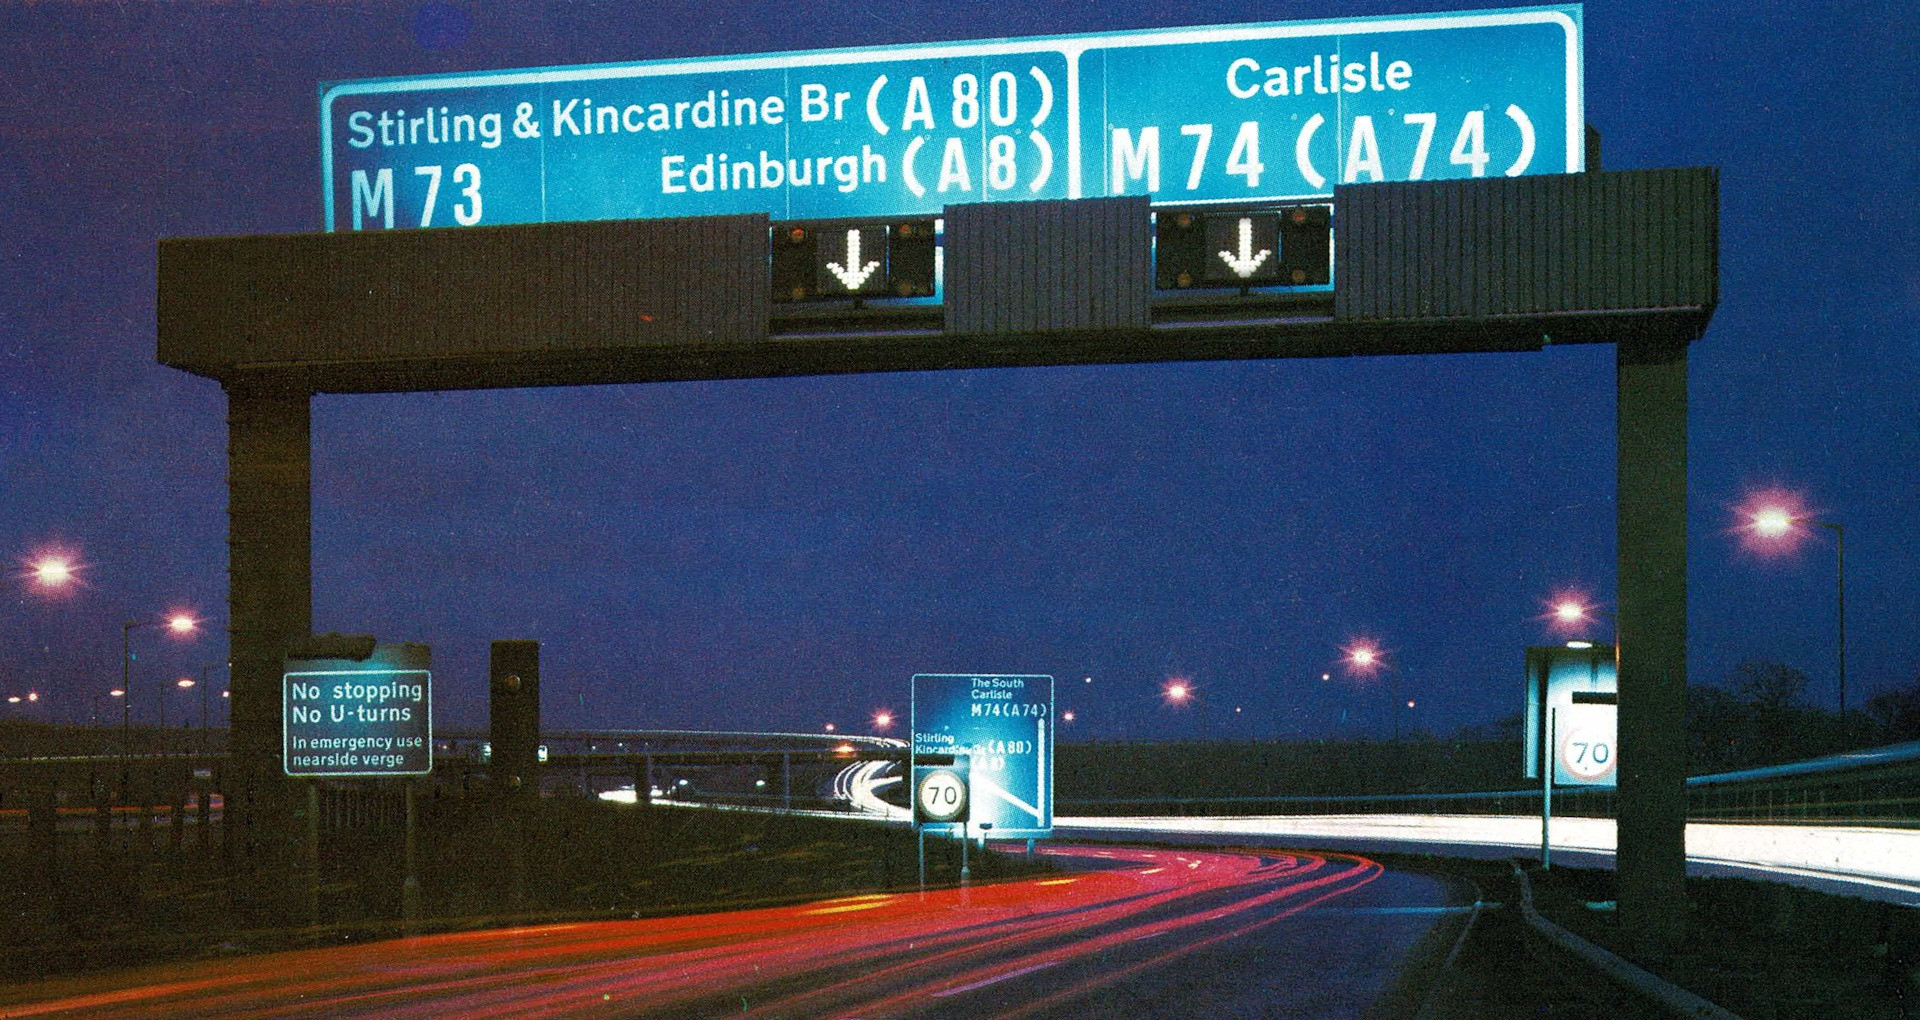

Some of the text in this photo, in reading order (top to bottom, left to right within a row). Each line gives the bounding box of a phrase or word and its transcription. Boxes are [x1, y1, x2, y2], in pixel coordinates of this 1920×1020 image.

[1227, 52, 1412, 98] Carlisle
[349, 107, 501, 149] Stirling
[513, 102, 541, 138] &
[554, 90, 785, 136] Kincardine
[801, 84, 851, 122] Br
[661, 144, 887, 193] Edinburgh
[292, 681, 422, 702] No stopping
[971, 678, 1024, 688] The South
[971, 689, 1013, 700] Carlisle
[292, 704, 411, 723] No U-turns
[293, 736, 422, 751] In emergency use
[915, 733, 954, 744] Stirling
[293, 752, 404, 769] nearside verge
[1572, 742, 1609, 764] 70
[928, 787, 957, 805] 70
